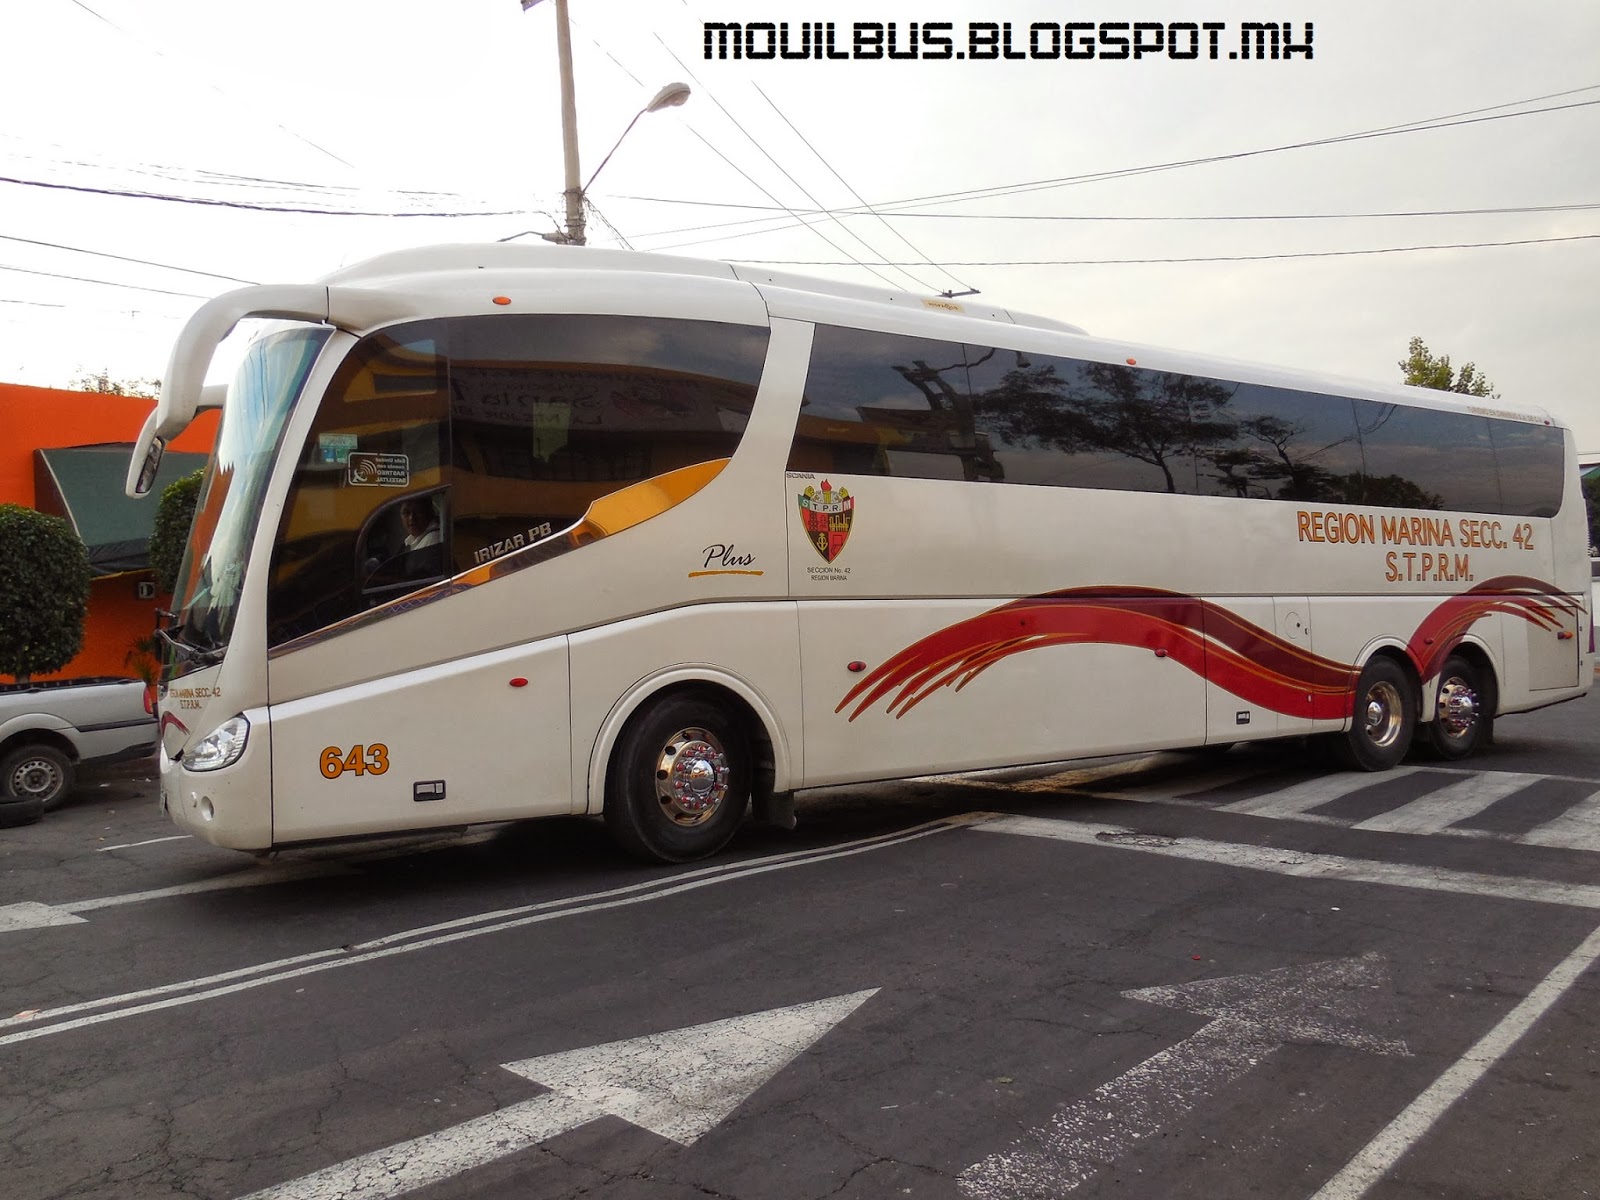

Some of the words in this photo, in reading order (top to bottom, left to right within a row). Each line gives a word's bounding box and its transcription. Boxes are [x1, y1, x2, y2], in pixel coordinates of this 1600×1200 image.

[786, 472, 816, 480] SCANIA
[473, 533, 525, 564] IRIZAR
[528, 521, 552, 542] PB
[1297, 511, 1375, 545] REGION
[1380, 515, 1455, 547] MARINA
[1460, 519, 1508, 550] SECC.
[1512, 523, 1535, 551] 42
[702, 543, 757, 569] Plus
[806, 566, 833, 574] SECCION
[1385, 551, 1474, 582] S.T.P.R.M.
[212, 687, 221, 697] 42
[319, 742, 390, 780] 643
